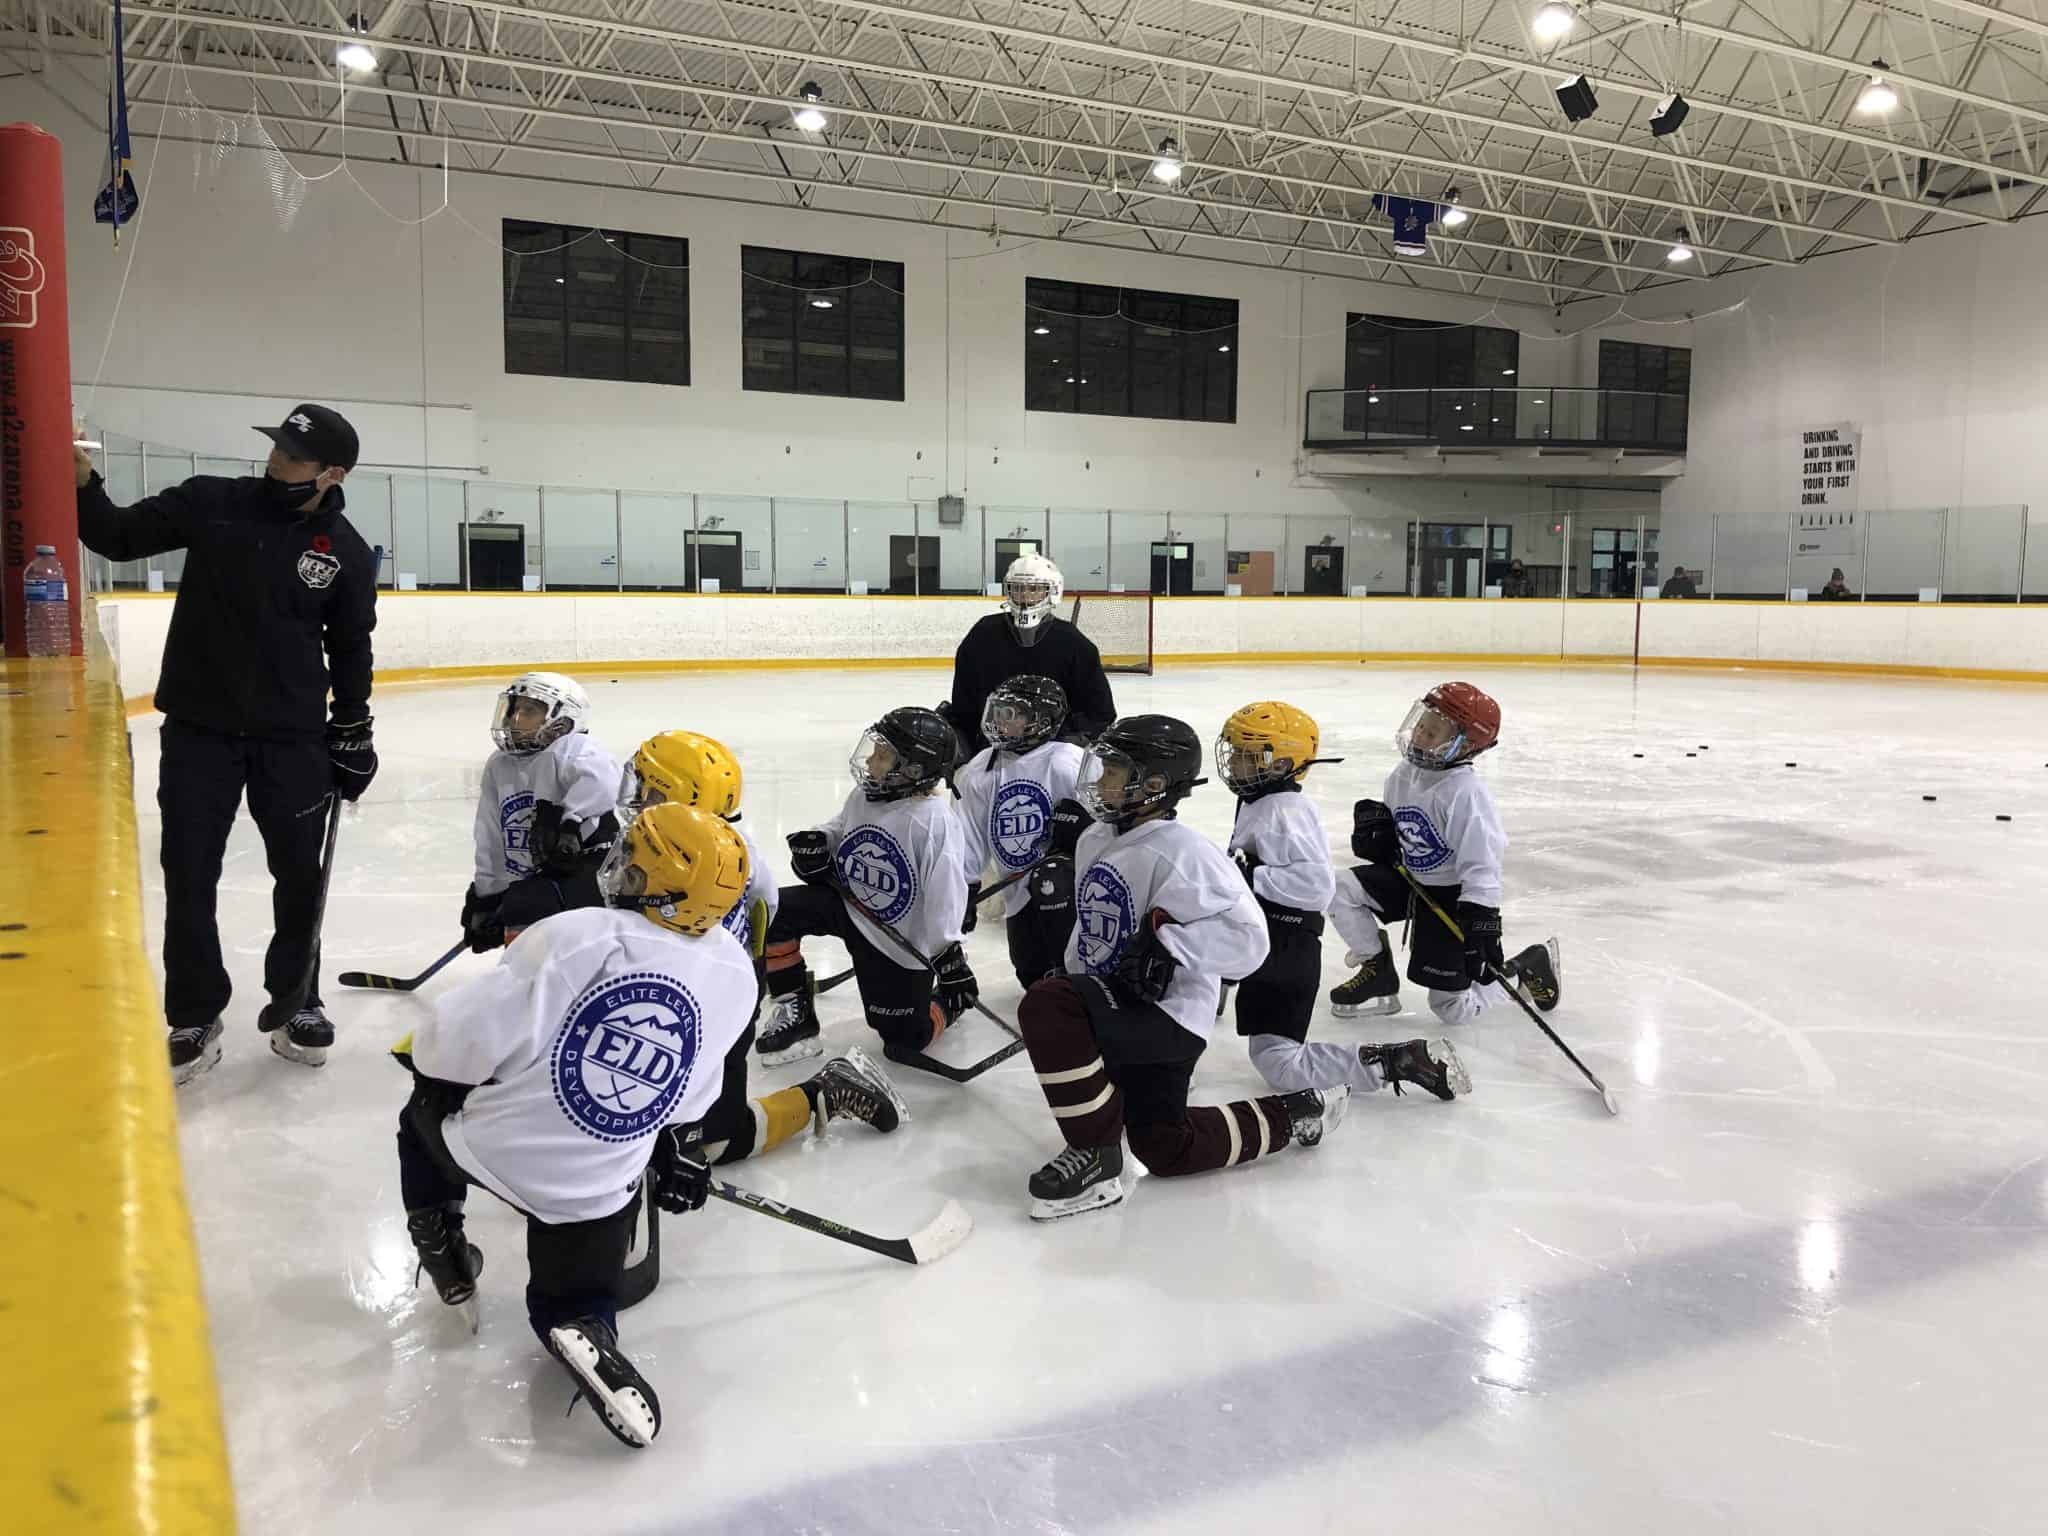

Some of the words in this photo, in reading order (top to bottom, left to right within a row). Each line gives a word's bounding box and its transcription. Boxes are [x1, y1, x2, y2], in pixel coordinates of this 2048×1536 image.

[1803, 430, 1839, 444] DRINKING
[1804, 447, 1820, 459] AND
[1822, 444, 1853, 458] DRIVING
[1803, 461, 1832, 474] STARTS
[1835, 460, 1856, 472] WITH
[1803, 477, 1824, 490] YOUR
[1827, 476, 1850, 488] FIRST
[1801, 492, 1829, 505] DRINK.
[1000, 814, 1041, 836] ELD
[847, 857, 896, 893] ELD
[606, 987, 660, 1009] ELITE
[664, 992, 692, 1037] LEVEL
[589, 1025, 675, 1086] ELD
[564, 1050, 673, 1130] DEVELOPMENT
